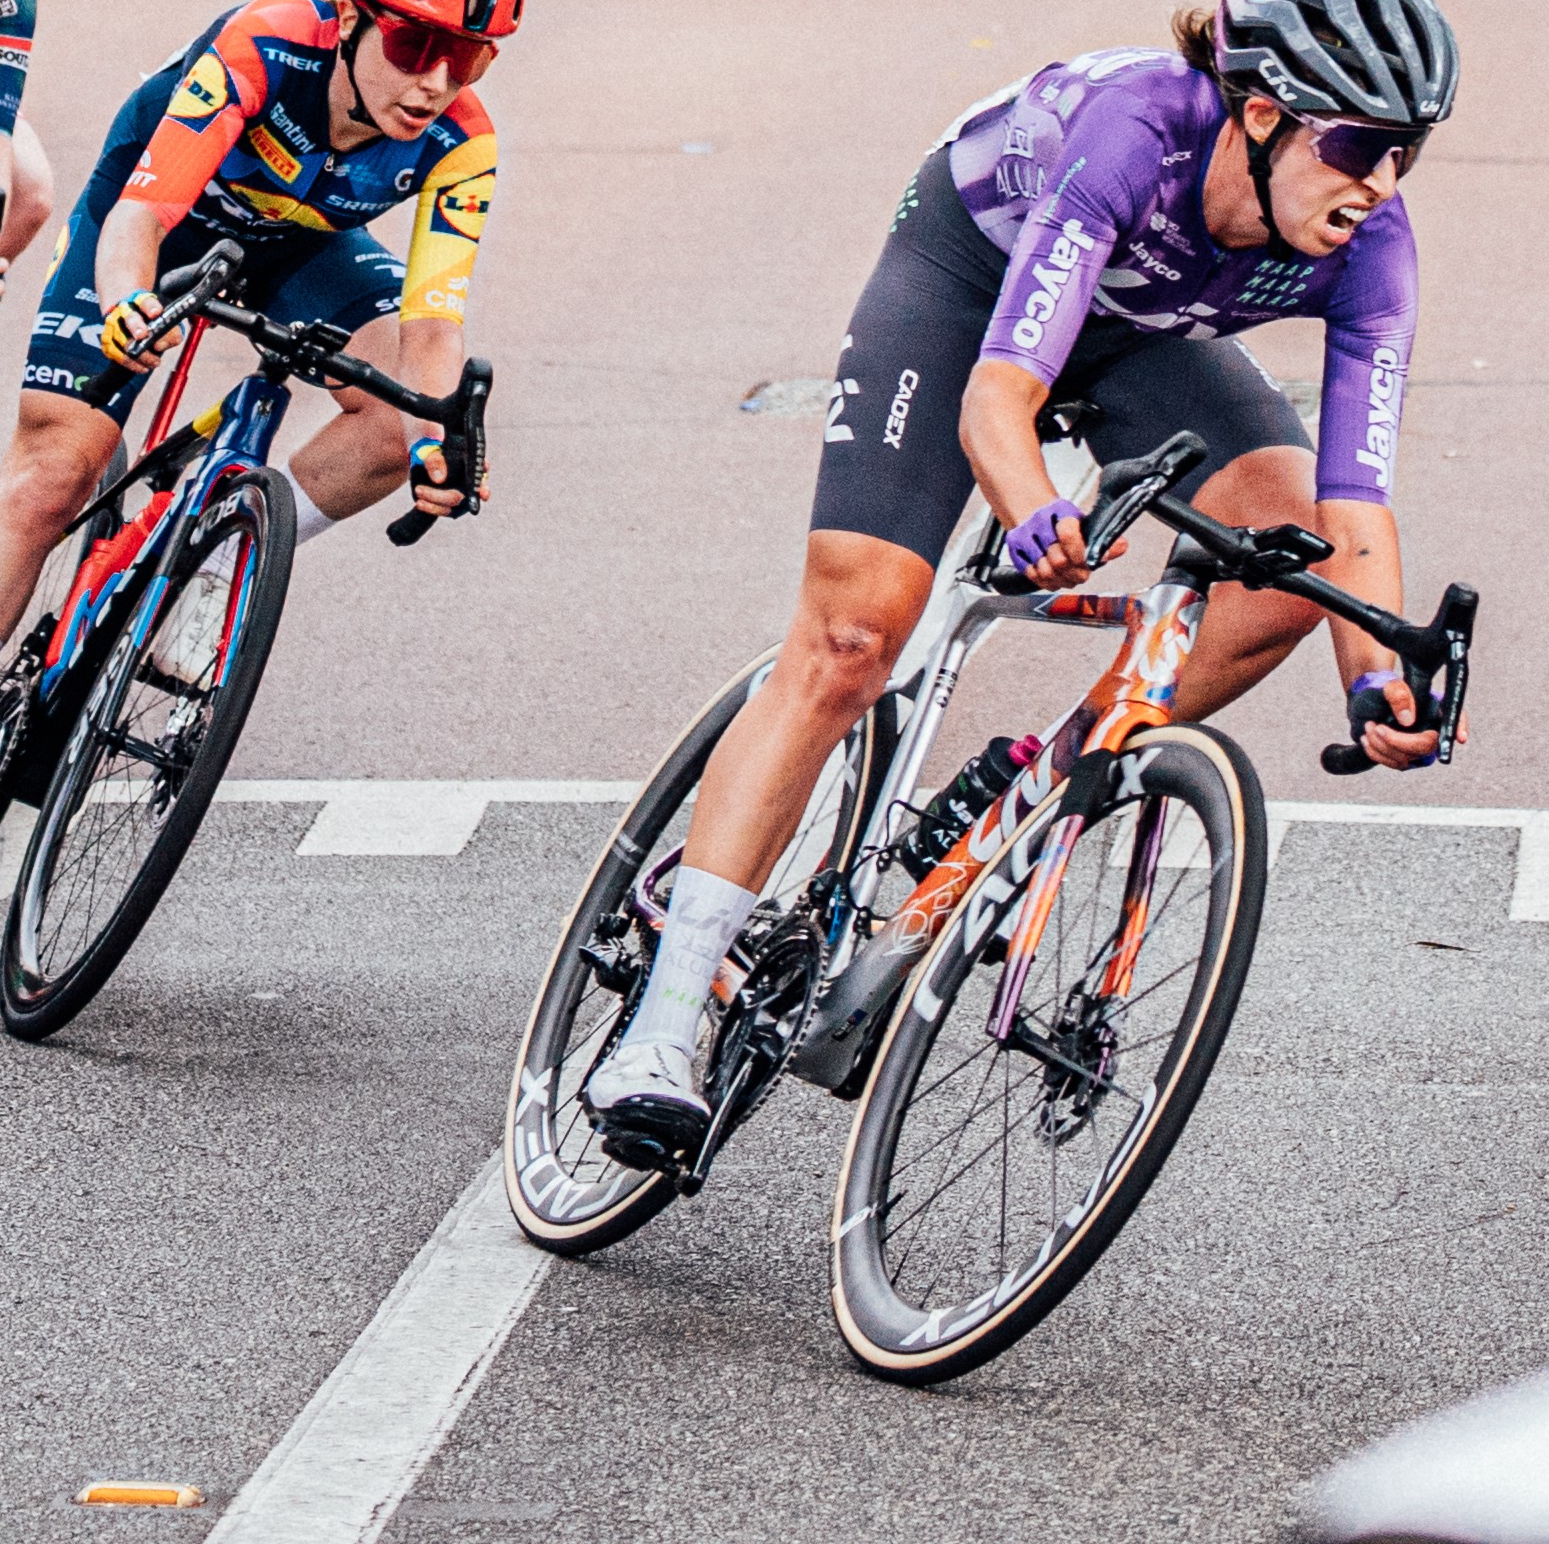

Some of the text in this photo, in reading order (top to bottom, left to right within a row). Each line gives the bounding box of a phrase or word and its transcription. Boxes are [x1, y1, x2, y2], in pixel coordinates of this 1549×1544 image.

[262, 46, 324, 73] TREK
[1259, 58, 1298, 103] Liv
[269, 101, 317, 155] Santini
[427, 124, 459, 149] EK
[1128, 240, 1183, 282] Jayco
[1254, 259, 1316, 279] MAAP
[1011, 217, 1096, 351] Jayco
[1235, 290, 1300, 307] MAAP
[1245, 275, 1308, 295] MAAP
[31, 311, 104, 350] EK
[882, 368, 920, 450] CADEX
[1356, 345, 1399, 488] Jayco
[514, 1065, 630, 1219] CADEX
